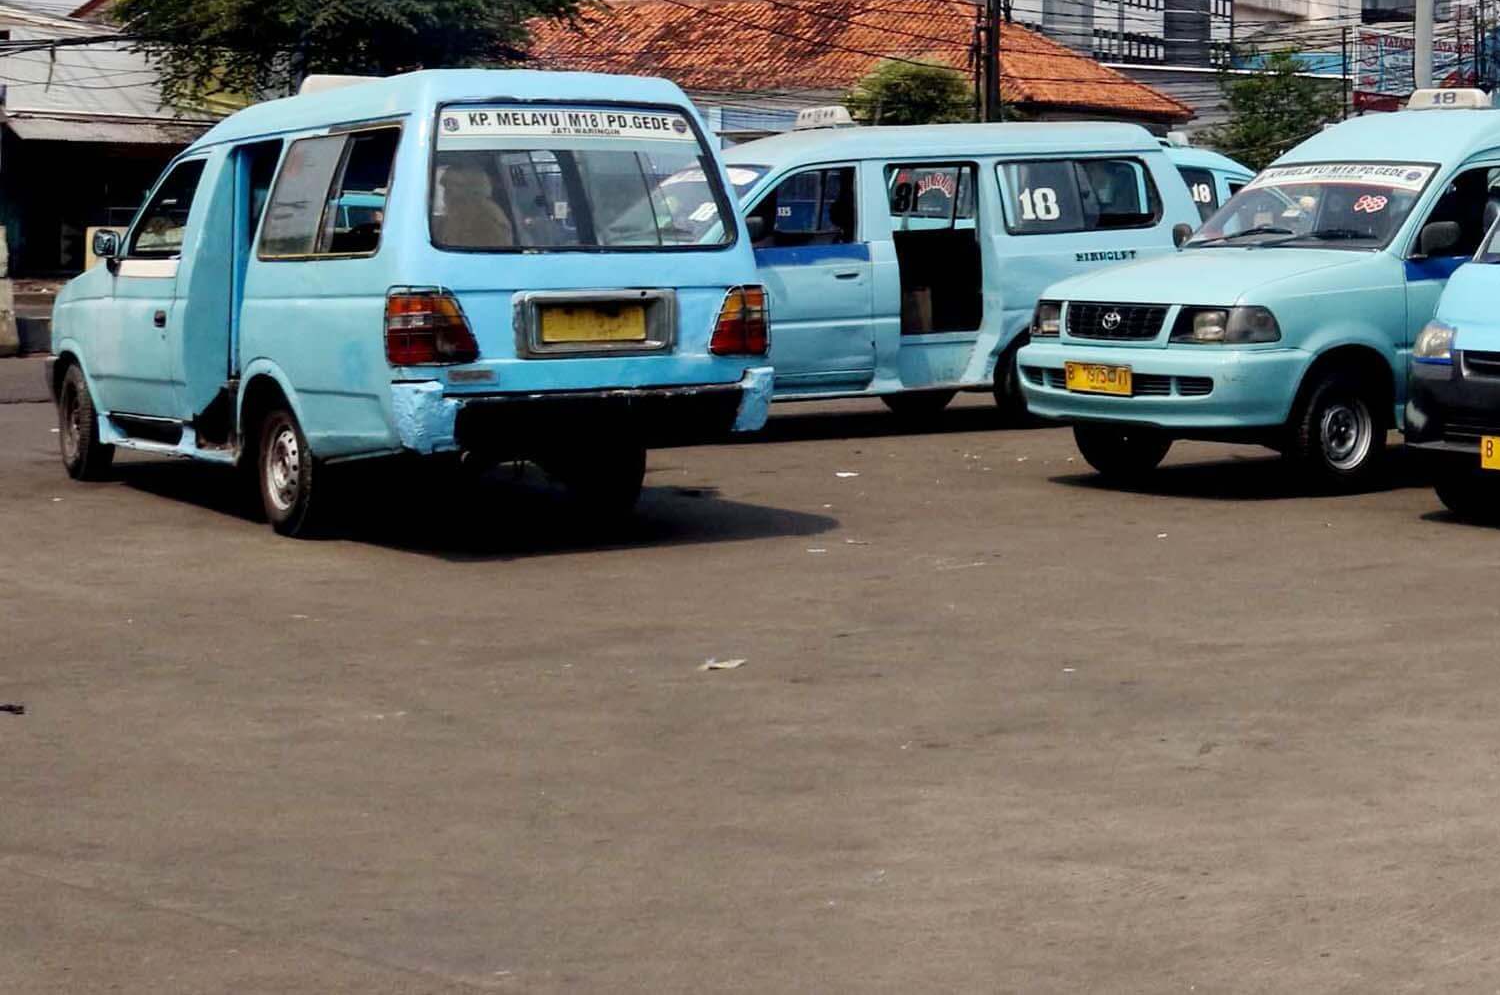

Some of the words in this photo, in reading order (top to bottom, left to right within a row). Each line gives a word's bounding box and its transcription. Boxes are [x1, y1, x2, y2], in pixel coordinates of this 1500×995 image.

[1432, 92, 1456, 105] 18
[468, 112, 491, 126] KP.
[496, 112, 560, 127] MELAYU
[568, 114, 600, 128] M18
[1191, 183, 1211, 203] 18
[1020, 187, 1060, 221] 18
[1486, 440, 1493, 459] B
